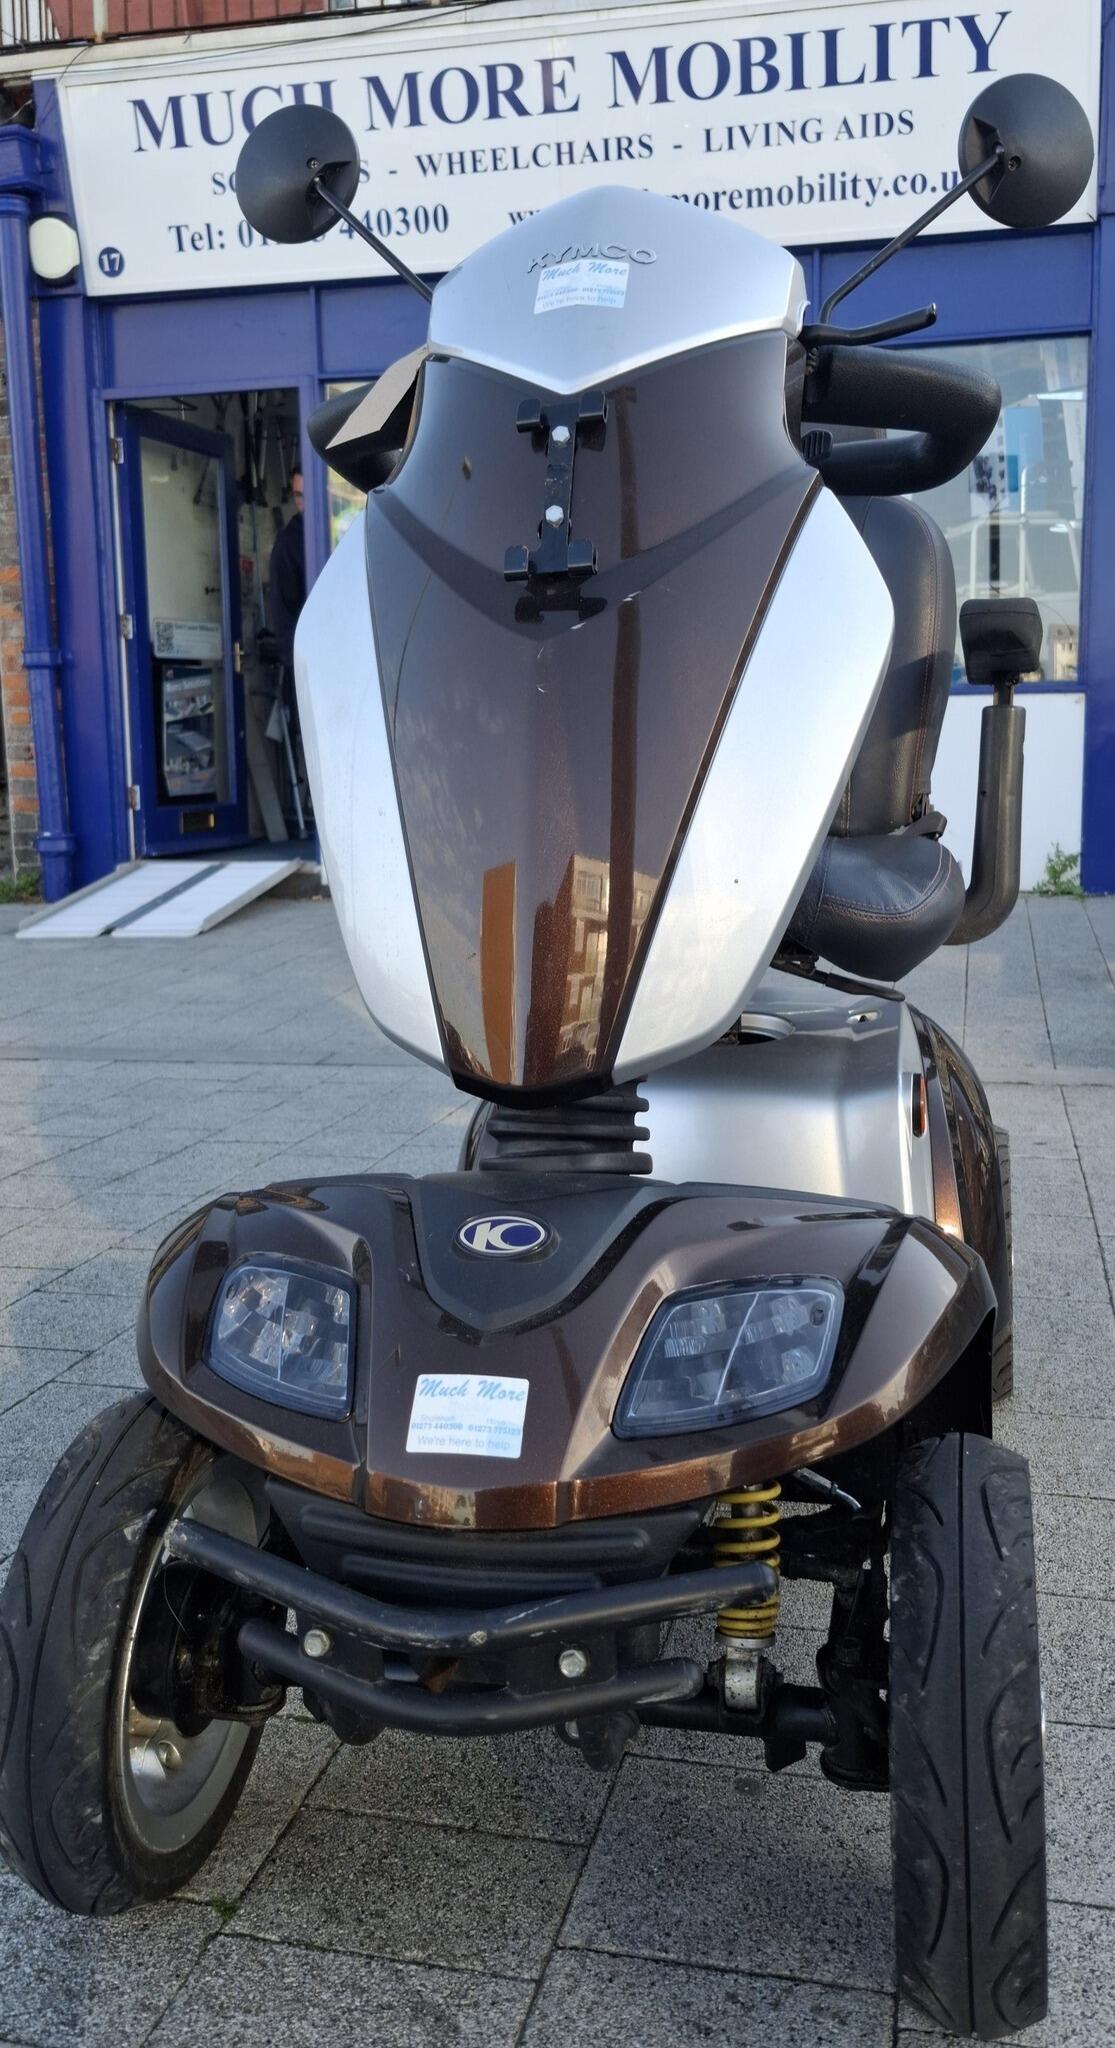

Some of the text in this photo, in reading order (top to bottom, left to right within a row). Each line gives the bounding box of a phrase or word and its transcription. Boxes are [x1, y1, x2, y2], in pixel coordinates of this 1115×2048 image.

[361, 55, 582, 131] MORE
[606, 10, 1014, 109] MOBILITY
[415, 133, 654, 178] WHEELCHAIRS
[704, 117, 824, 153] LIVING
[834, 108, 915, 142] AIDS
[168, 222, 226, 253] Tel:
[101, 252, 121, 272] 17
[527, 244, 657, 274] KYMCO
[542, 261, 628, 282] Much More
[418, 1378, 526, 1402] Much More
[448, 1437, 472, 1448] here
[475, 1439, 485, 1449] to
[487, 1440, 511, 1452] help
